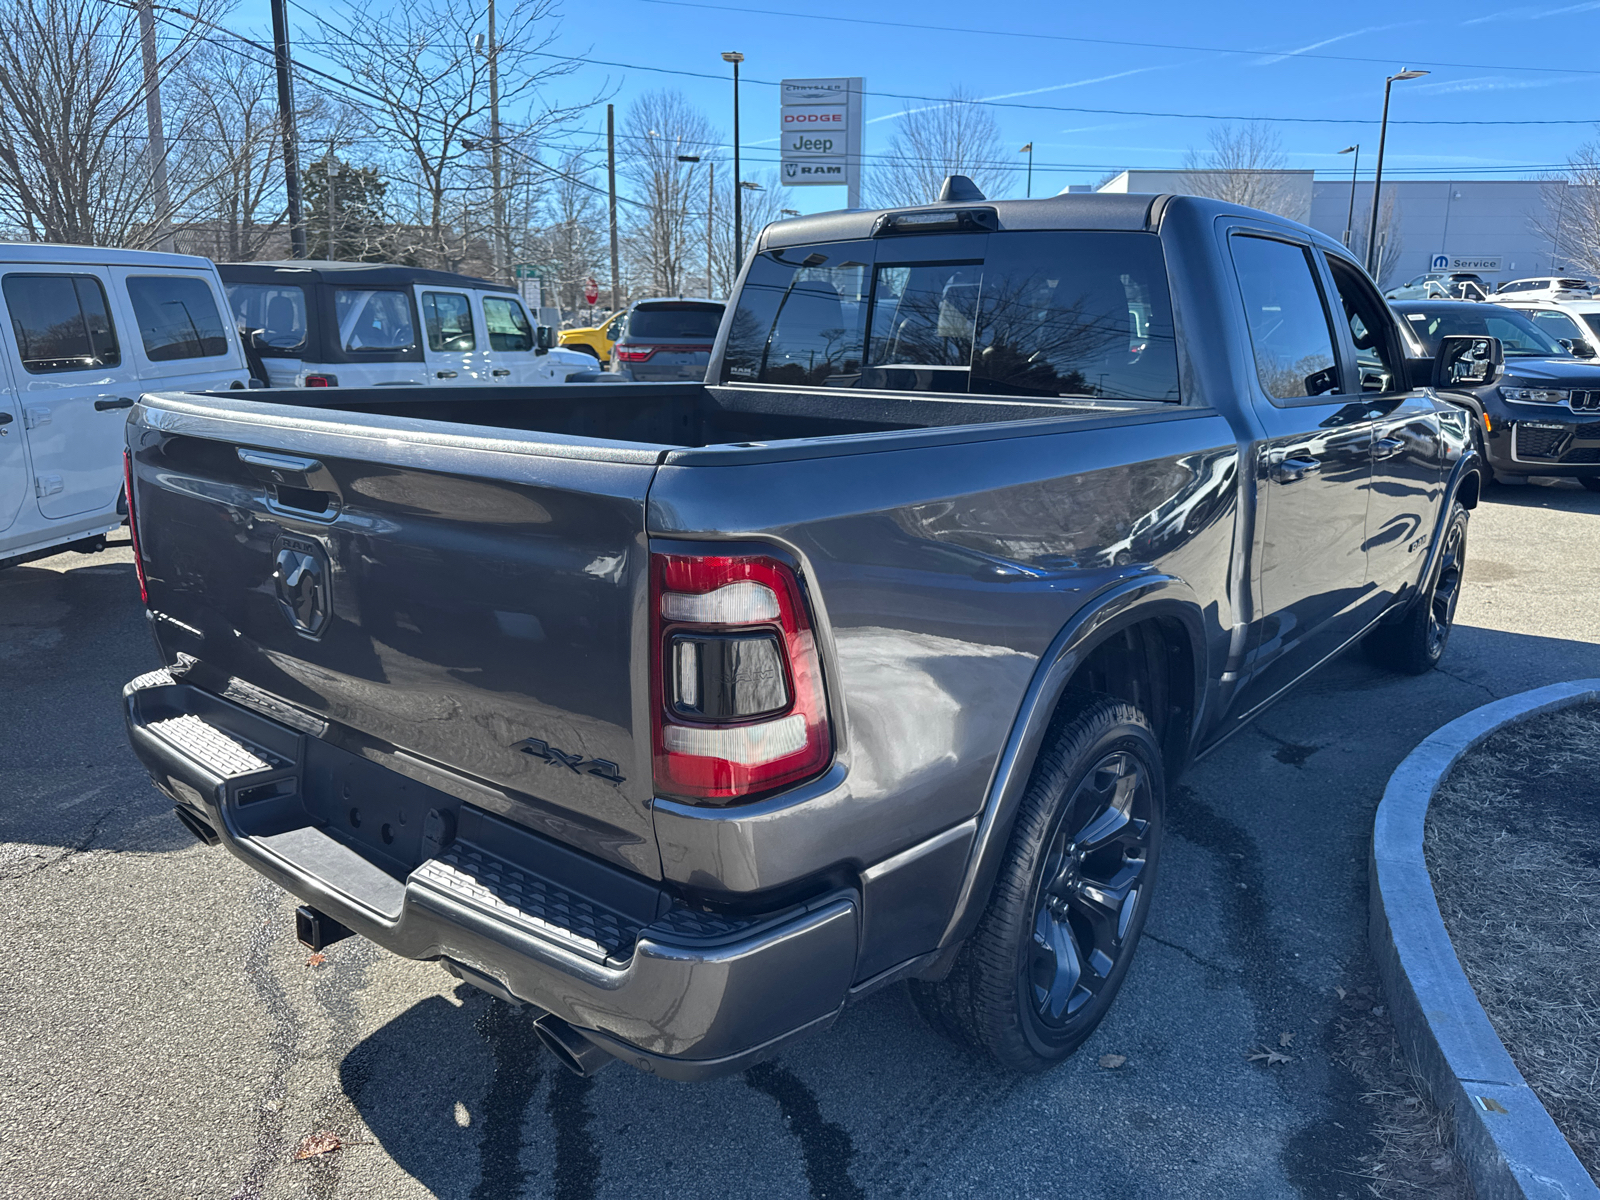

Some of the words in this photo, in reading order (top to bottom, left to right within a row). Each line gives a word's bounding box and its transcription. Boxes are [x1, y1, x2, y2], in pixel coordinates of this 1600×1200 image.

[784, 114, 842, 123] DODGE
[793, 135, 833, 153] Jeep
[801, 166, 842, 174] RAM
[1453, 259, 1497, 268] Service
[283, 540, 313, 552] RAM
[712, 669, 774, 684] RAM
